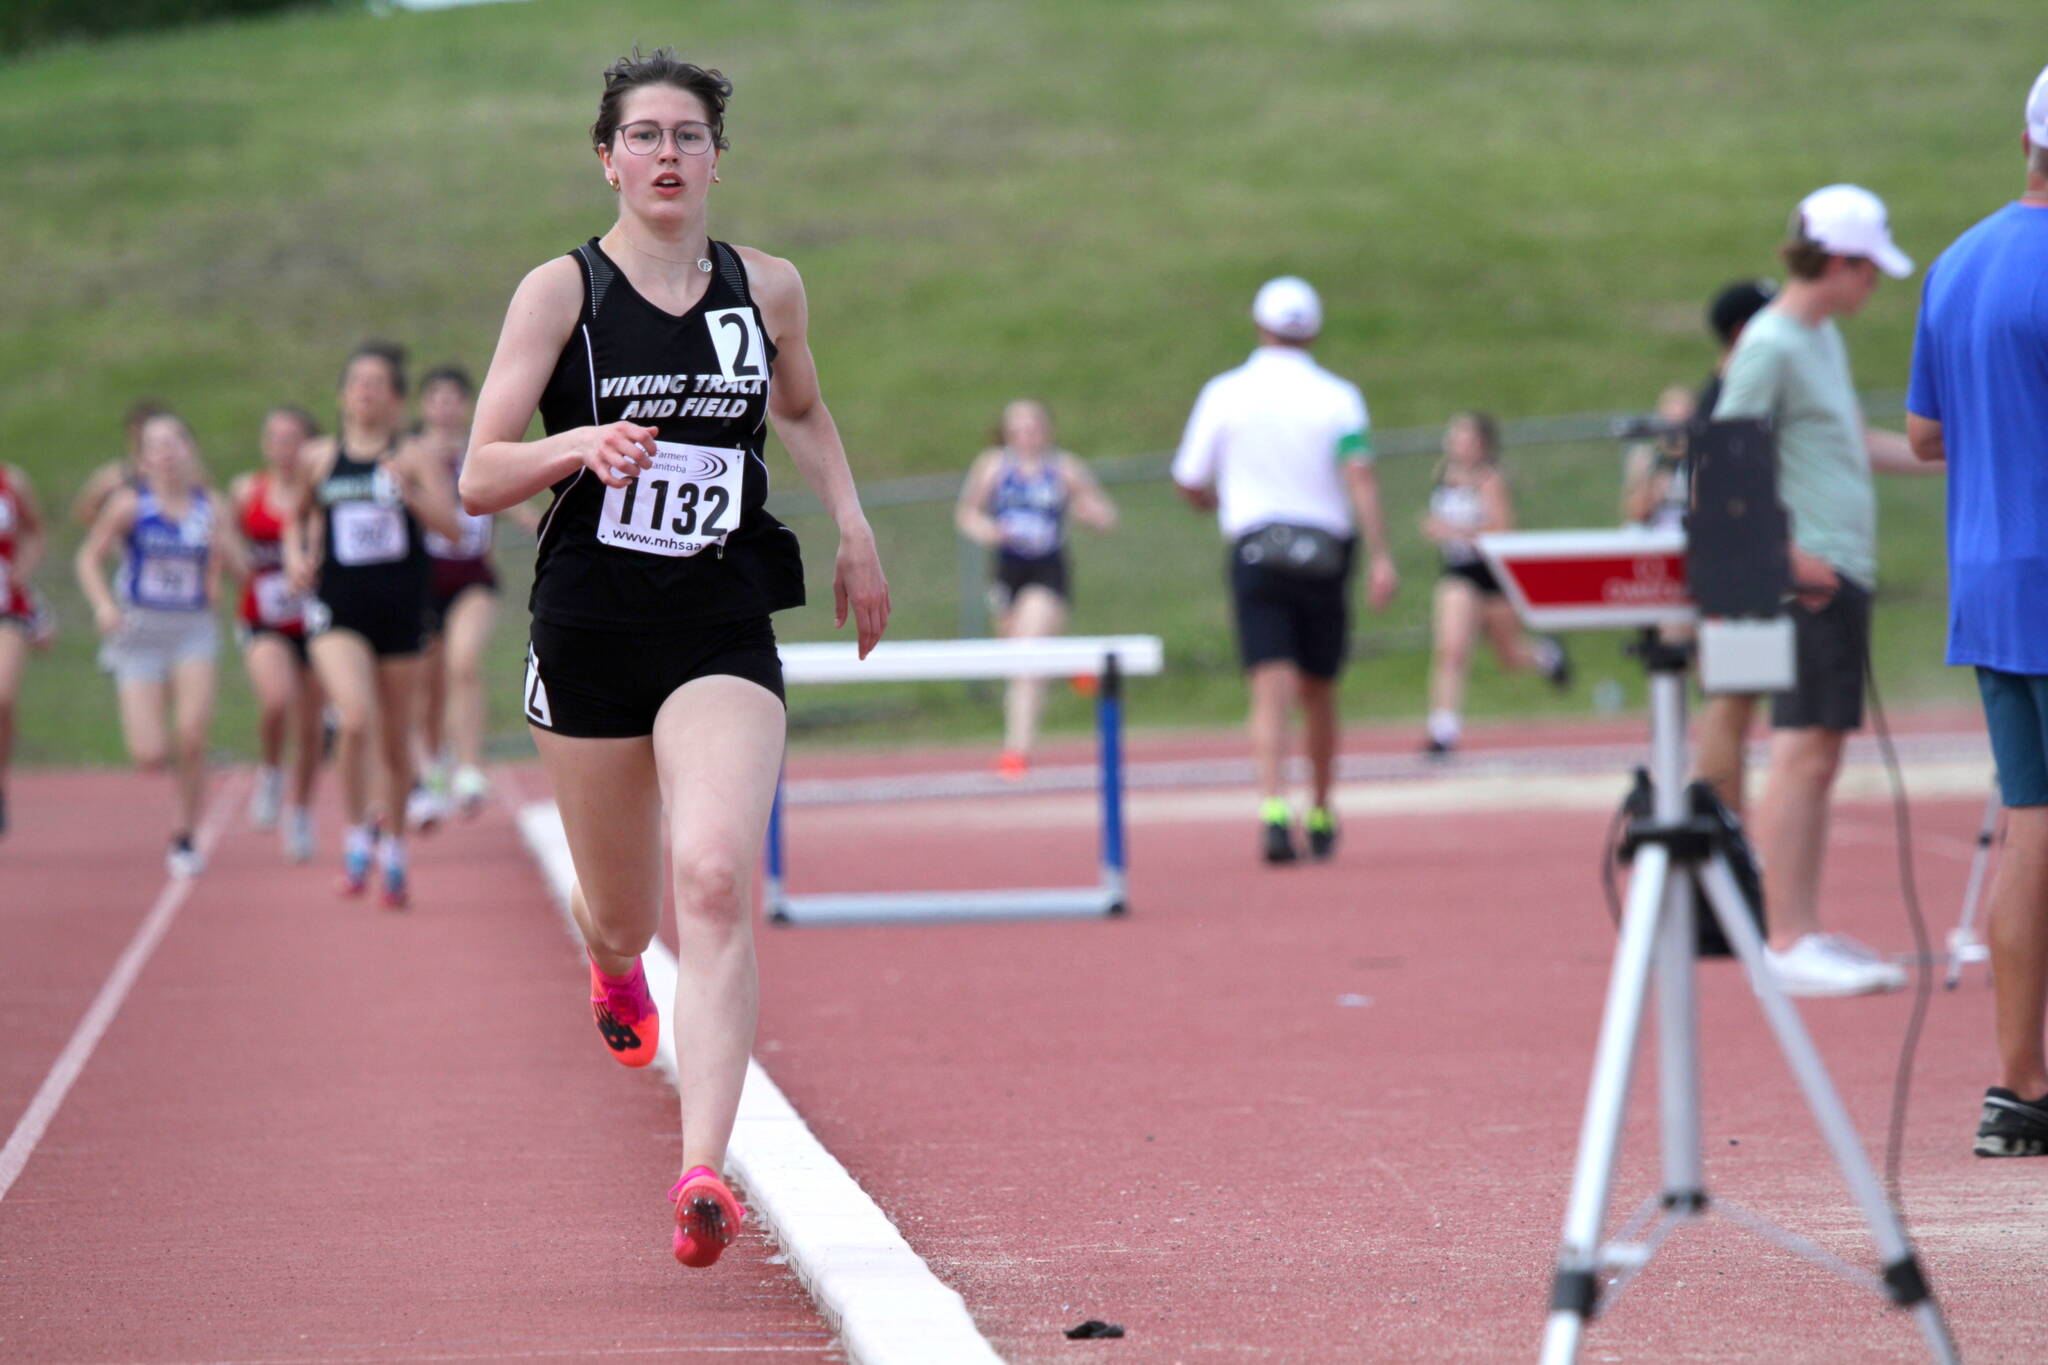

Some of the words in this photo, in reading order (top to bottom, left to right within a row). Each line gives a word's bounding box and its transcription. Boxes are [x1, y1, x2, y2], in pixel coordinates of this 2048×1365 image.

[719, 313, 760, 377] 2
[600, 374, 688, 398] VIKING
[693, 374, 763, 395] TRACK
[620, 398, 677, 420] AND
[680, 397, 748, 418] FIELD
[652, 462, 687, 474] anitoba
[620, 476, 730, 537] 1132
